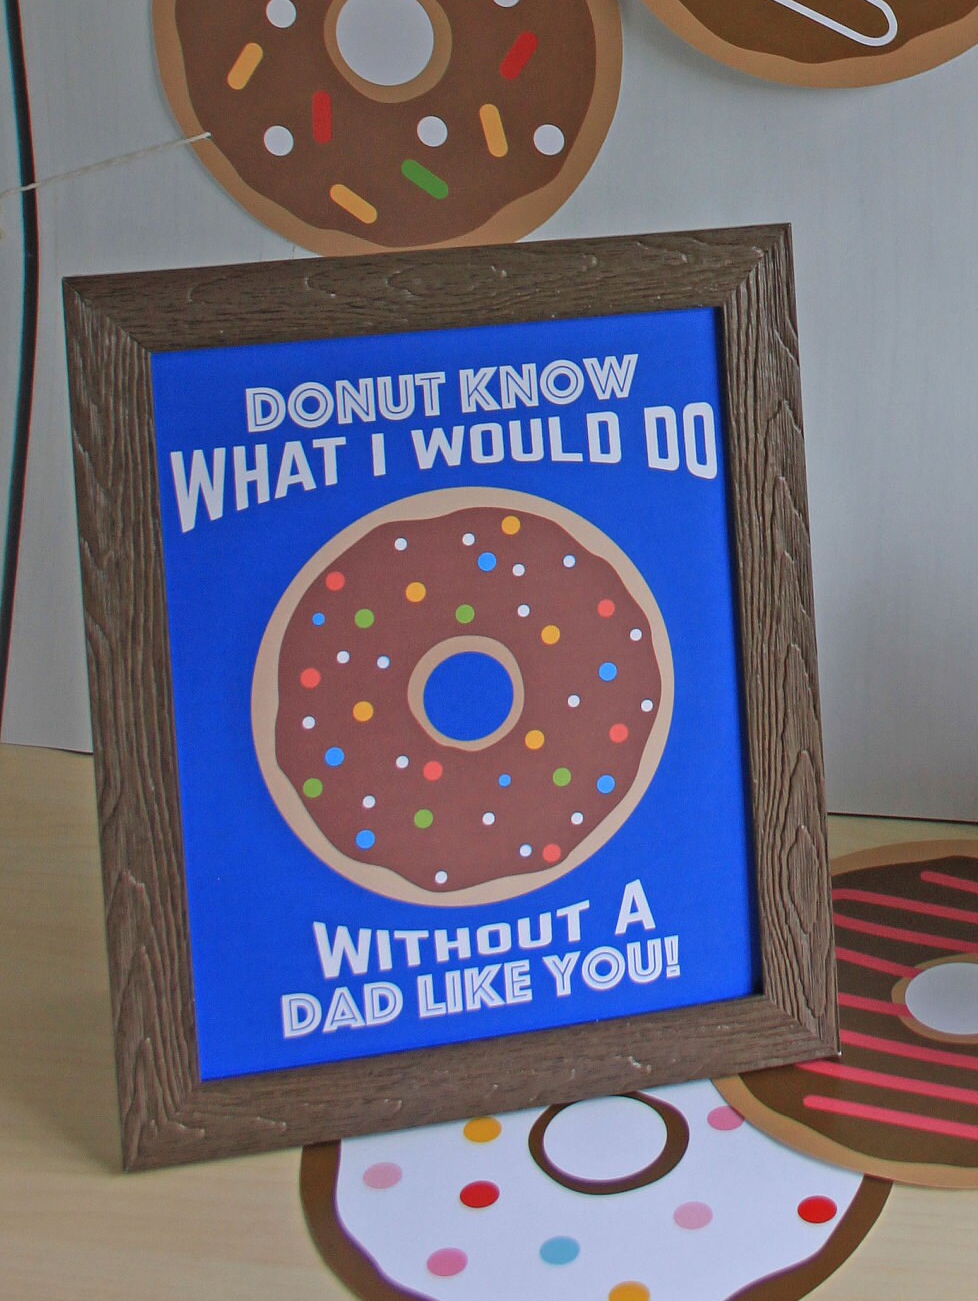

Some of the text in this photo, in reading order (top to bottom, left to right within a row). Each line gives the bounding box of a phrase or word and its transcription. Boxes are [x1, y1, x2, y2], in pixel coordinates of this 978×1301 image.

[245, 353, 638, 432] DONUT KNOW
[170, 401, 718, 533] WHAT I WOULD DO
[313, 879, 655, 979] WITHOUT A
[281, 935, 681, 1039] DAD LIKE YOU!
